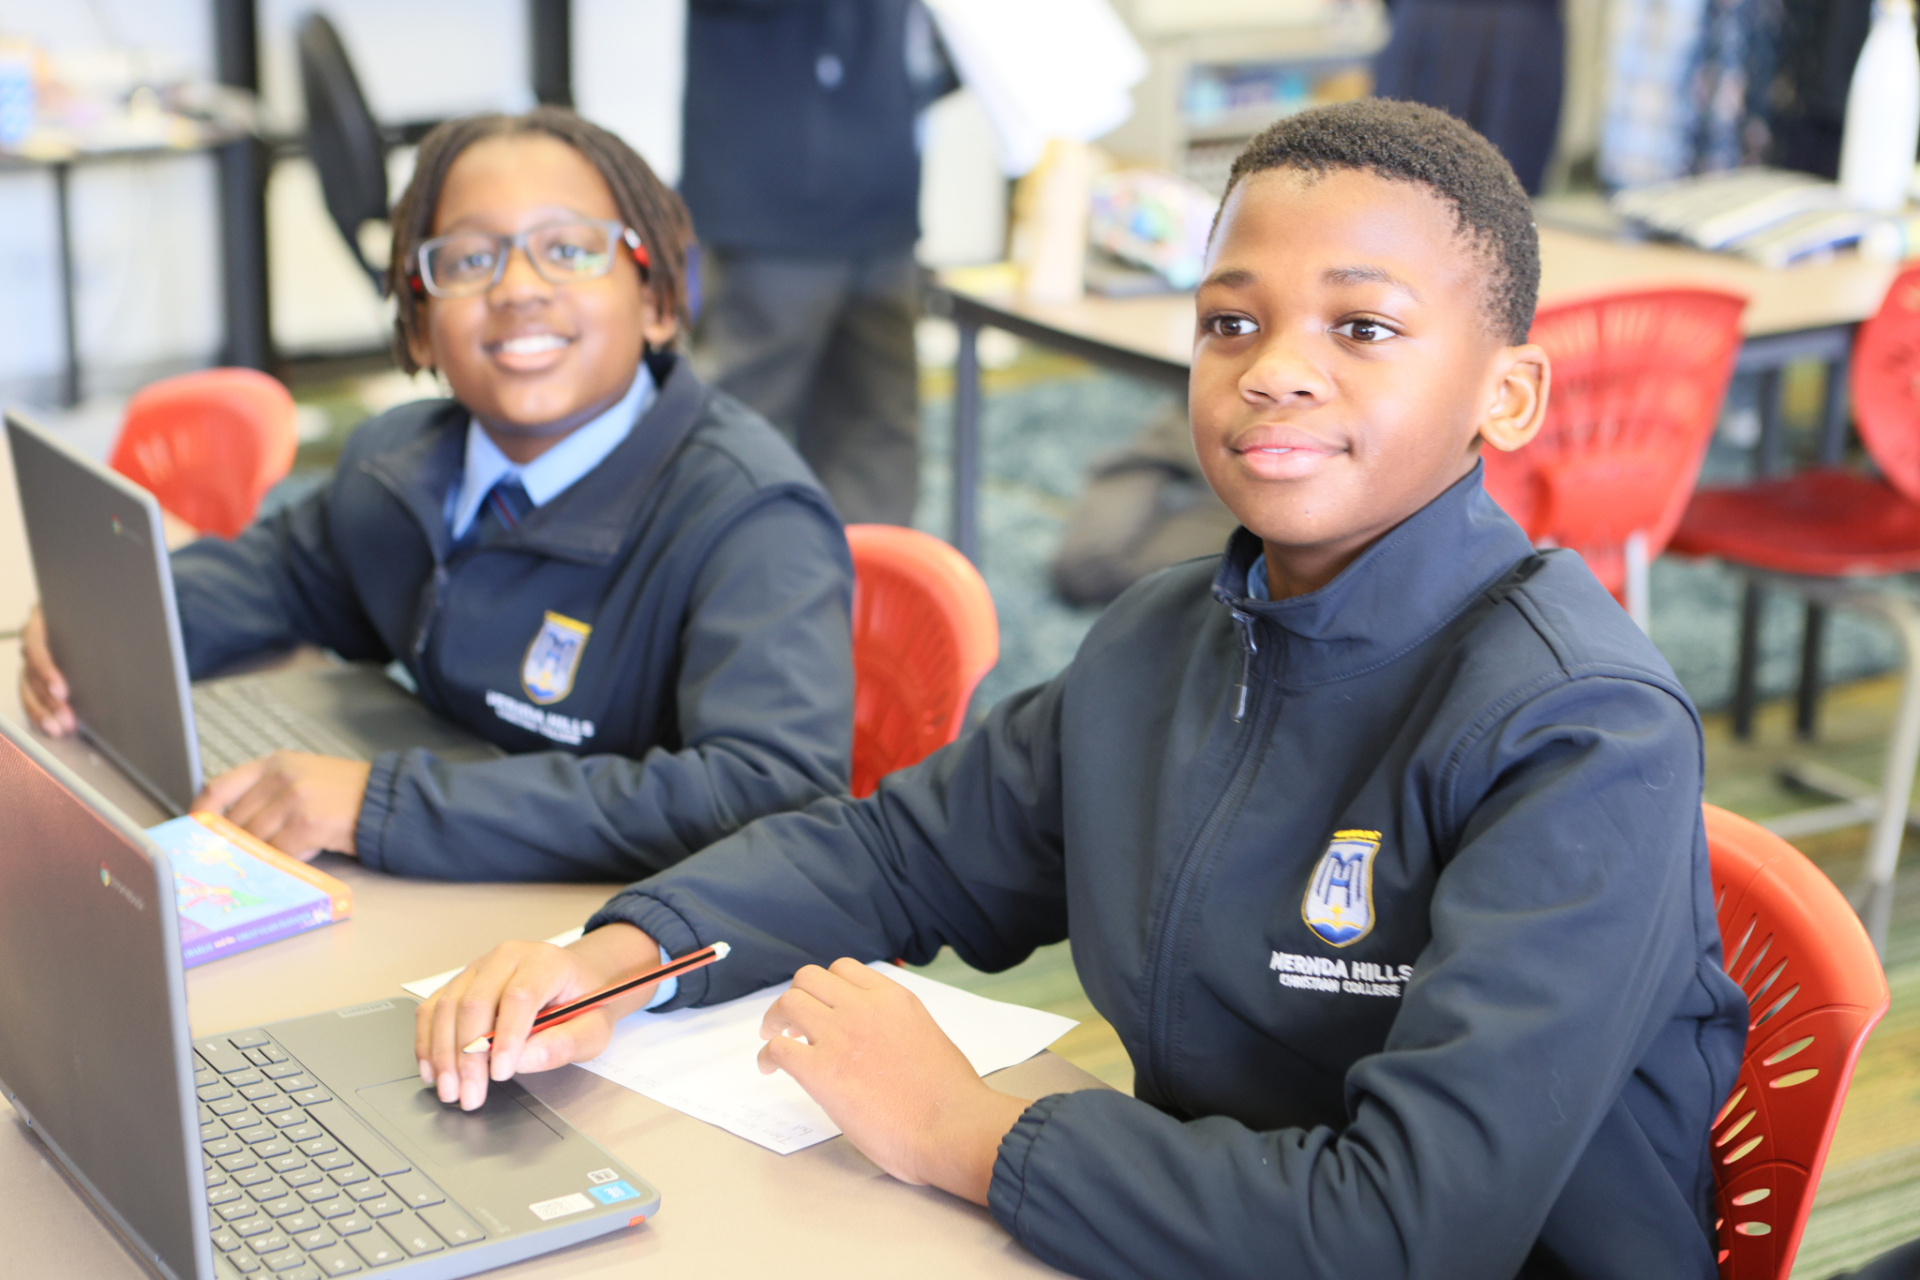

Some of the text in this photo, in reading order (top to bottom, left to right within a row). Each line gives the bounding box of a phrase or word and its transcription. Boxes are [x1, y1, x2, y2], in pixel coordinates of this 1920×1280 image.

[1351, 960, 1414, 983] HILLS
[1279, 972, 1402, 998] CHRISTIAN COLLEGE
